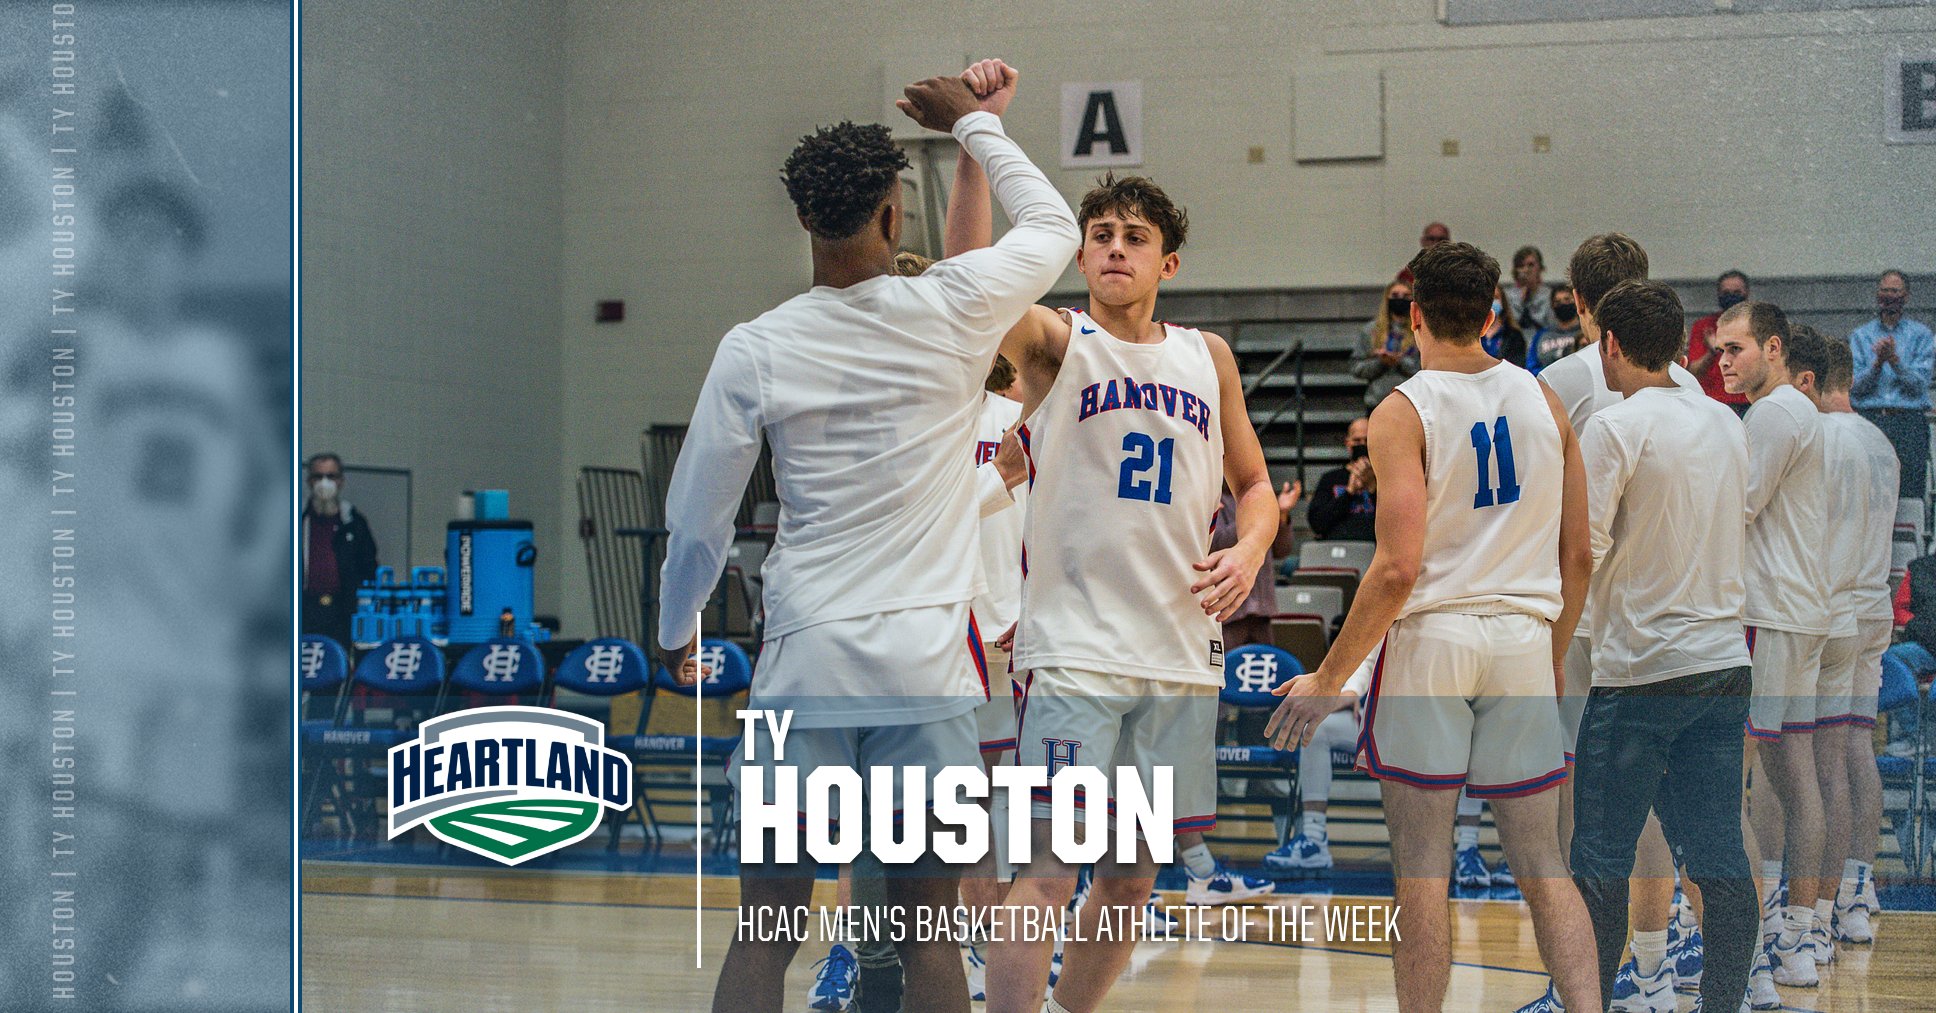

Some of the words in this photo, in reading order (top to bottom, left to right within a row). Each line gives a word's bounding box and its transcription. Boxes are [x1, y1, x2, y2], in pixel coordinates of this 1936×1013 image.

[1073, 91, 1129, 156] A
[1900, 62, 1936, 131] B
[1078, 377, 1211, 442] HANOVER
[1117, 431, 1174, 505] 21
[1470, 415, 1521, 510] 11
[461, 535, 473, 613] POWERADE
[1042, 737, 1082, 778] H
[1216, 747, 1251, 762] OVER
